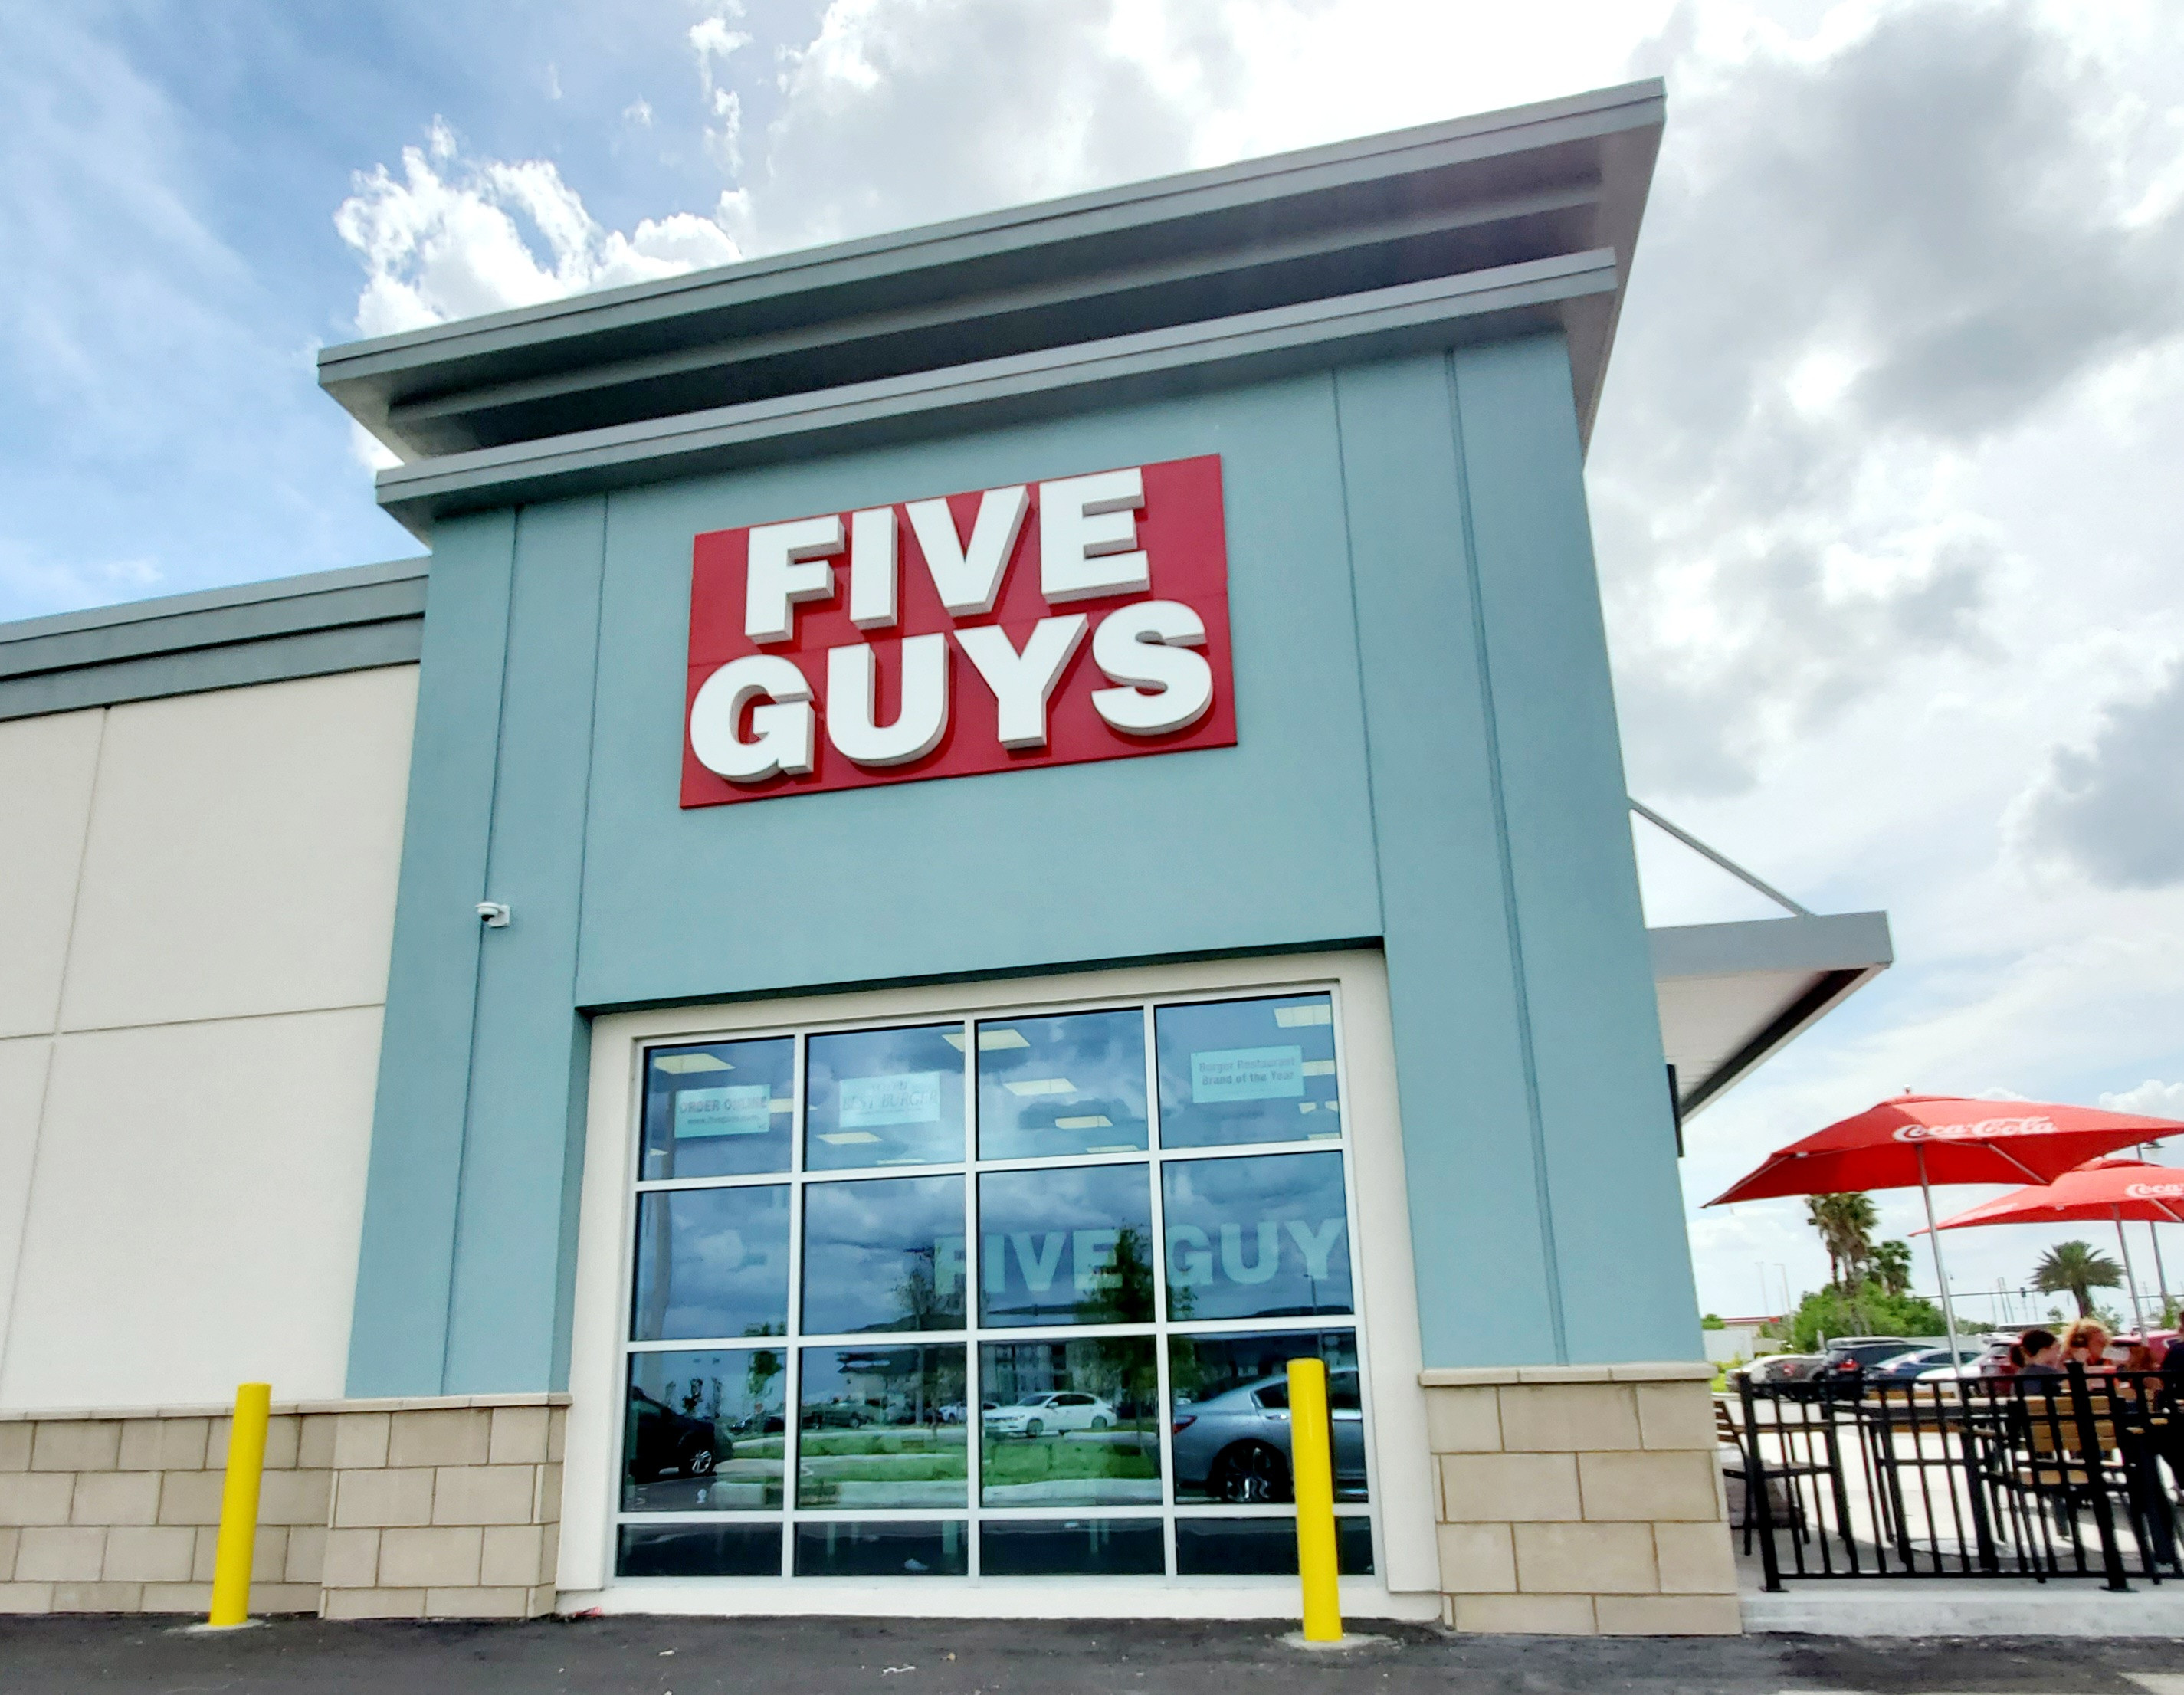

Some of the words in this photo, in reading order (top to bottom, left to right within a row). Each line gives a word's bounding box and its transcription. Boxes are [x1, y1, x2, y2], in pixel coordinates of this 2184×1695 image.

[744, 467, 1149, 645] FIVE
[690, 599, 1214, 783] GUYS
[1199, 1063, 1234, 1073] Burger
[1238, 1057, 1295, 1069] Restaurant
[1202, 1074, 1232, 1085] Brand
[1236, 1073, 1247, 1084] of
[1250, 1072, 1267, 1083] the
[1271, 1070, 1294, 1080] Year
[934, 1228, 1123, 1294] FIVE
